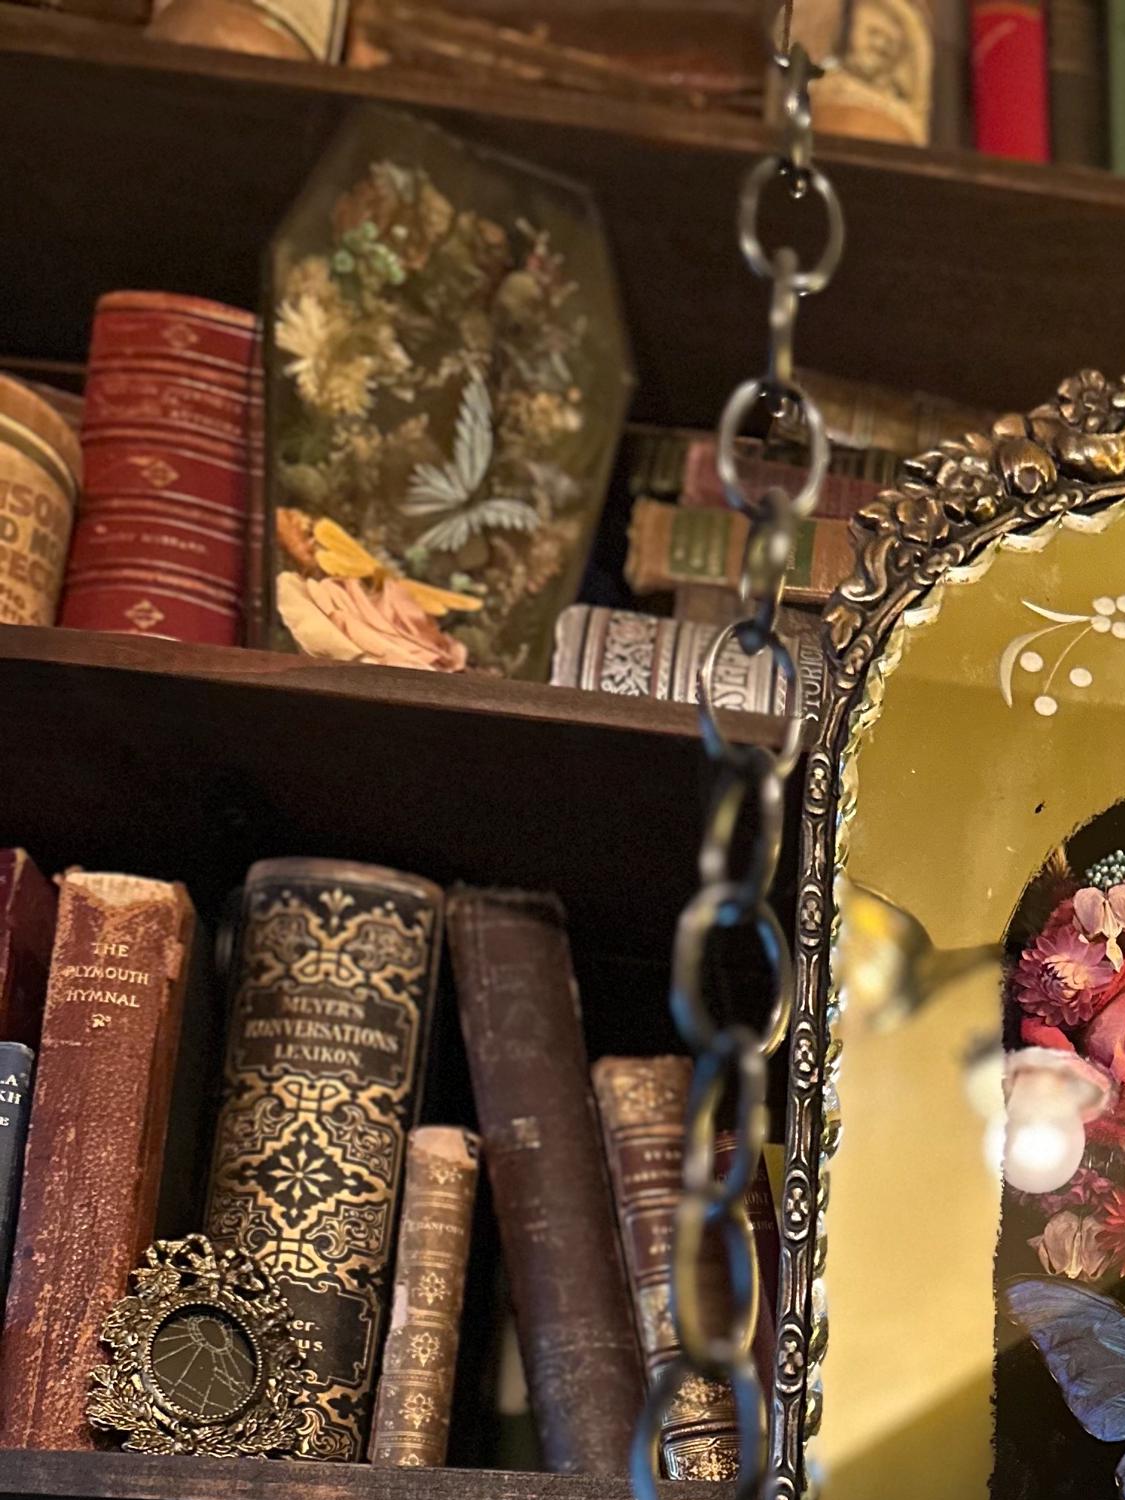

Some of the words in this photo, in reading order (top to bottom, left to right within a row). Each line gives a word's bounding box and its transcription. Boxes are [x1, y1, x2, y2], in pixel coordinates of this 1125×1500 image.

[92, 943, 129, 958] THE
[63, 964, 149, 985] PLYMOUTH
[66, 989, 140, 1008] HYMNAL
[245, 1019, 399, 1053] KONVERSATIONS
